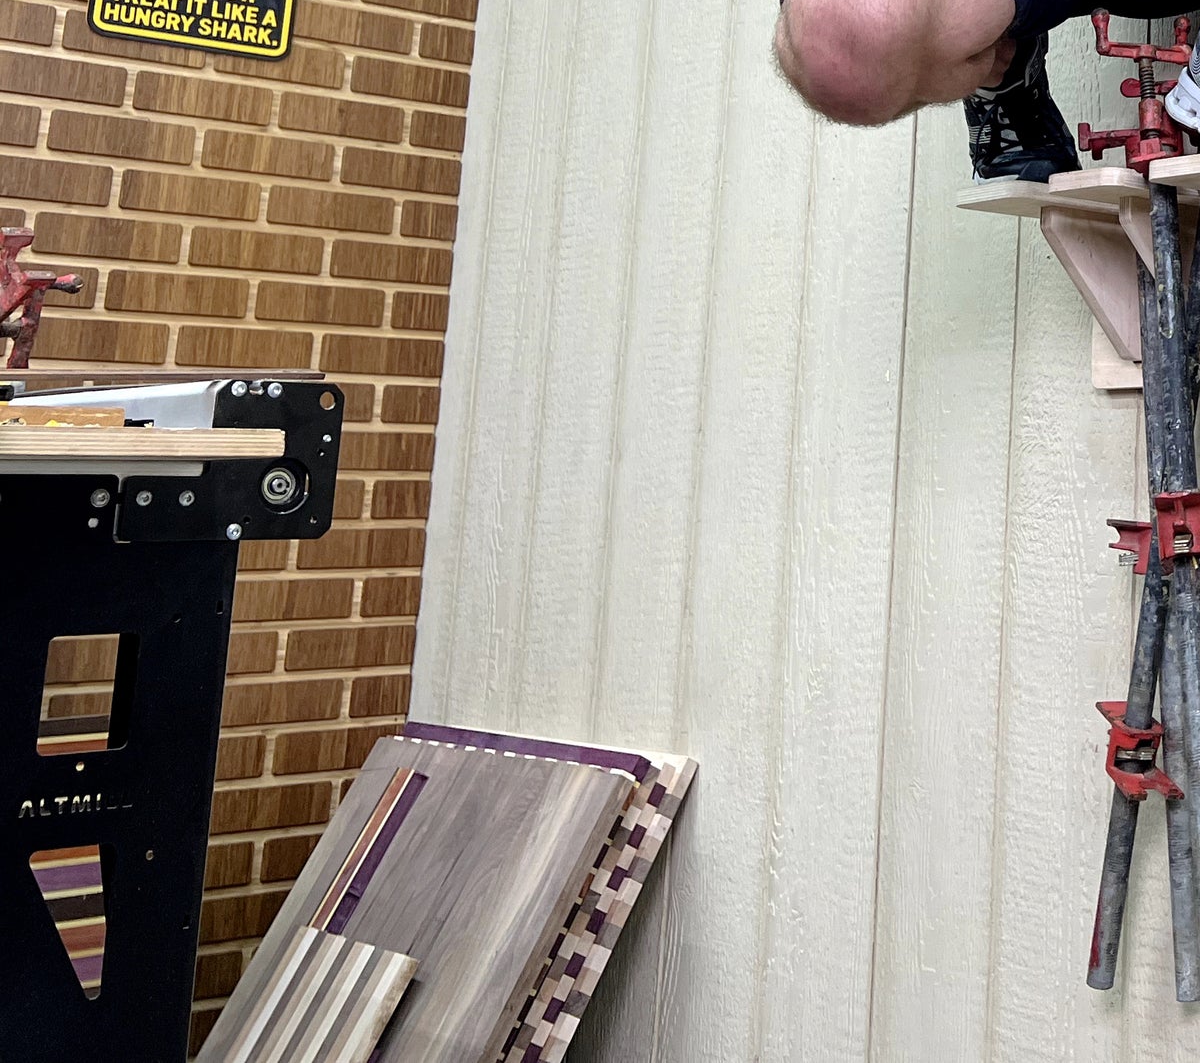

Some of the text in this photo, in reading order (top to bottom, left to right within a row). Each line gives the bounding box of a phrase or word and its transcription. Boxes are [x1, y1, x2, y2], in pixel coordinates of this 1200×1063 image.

[104, 3, 278, 46] HUNGRY SHARK.
[211, 2, 258, 24] LIKE
[262, 10, 277, 27] A
[18, 793, 133, 818] ALTMI
